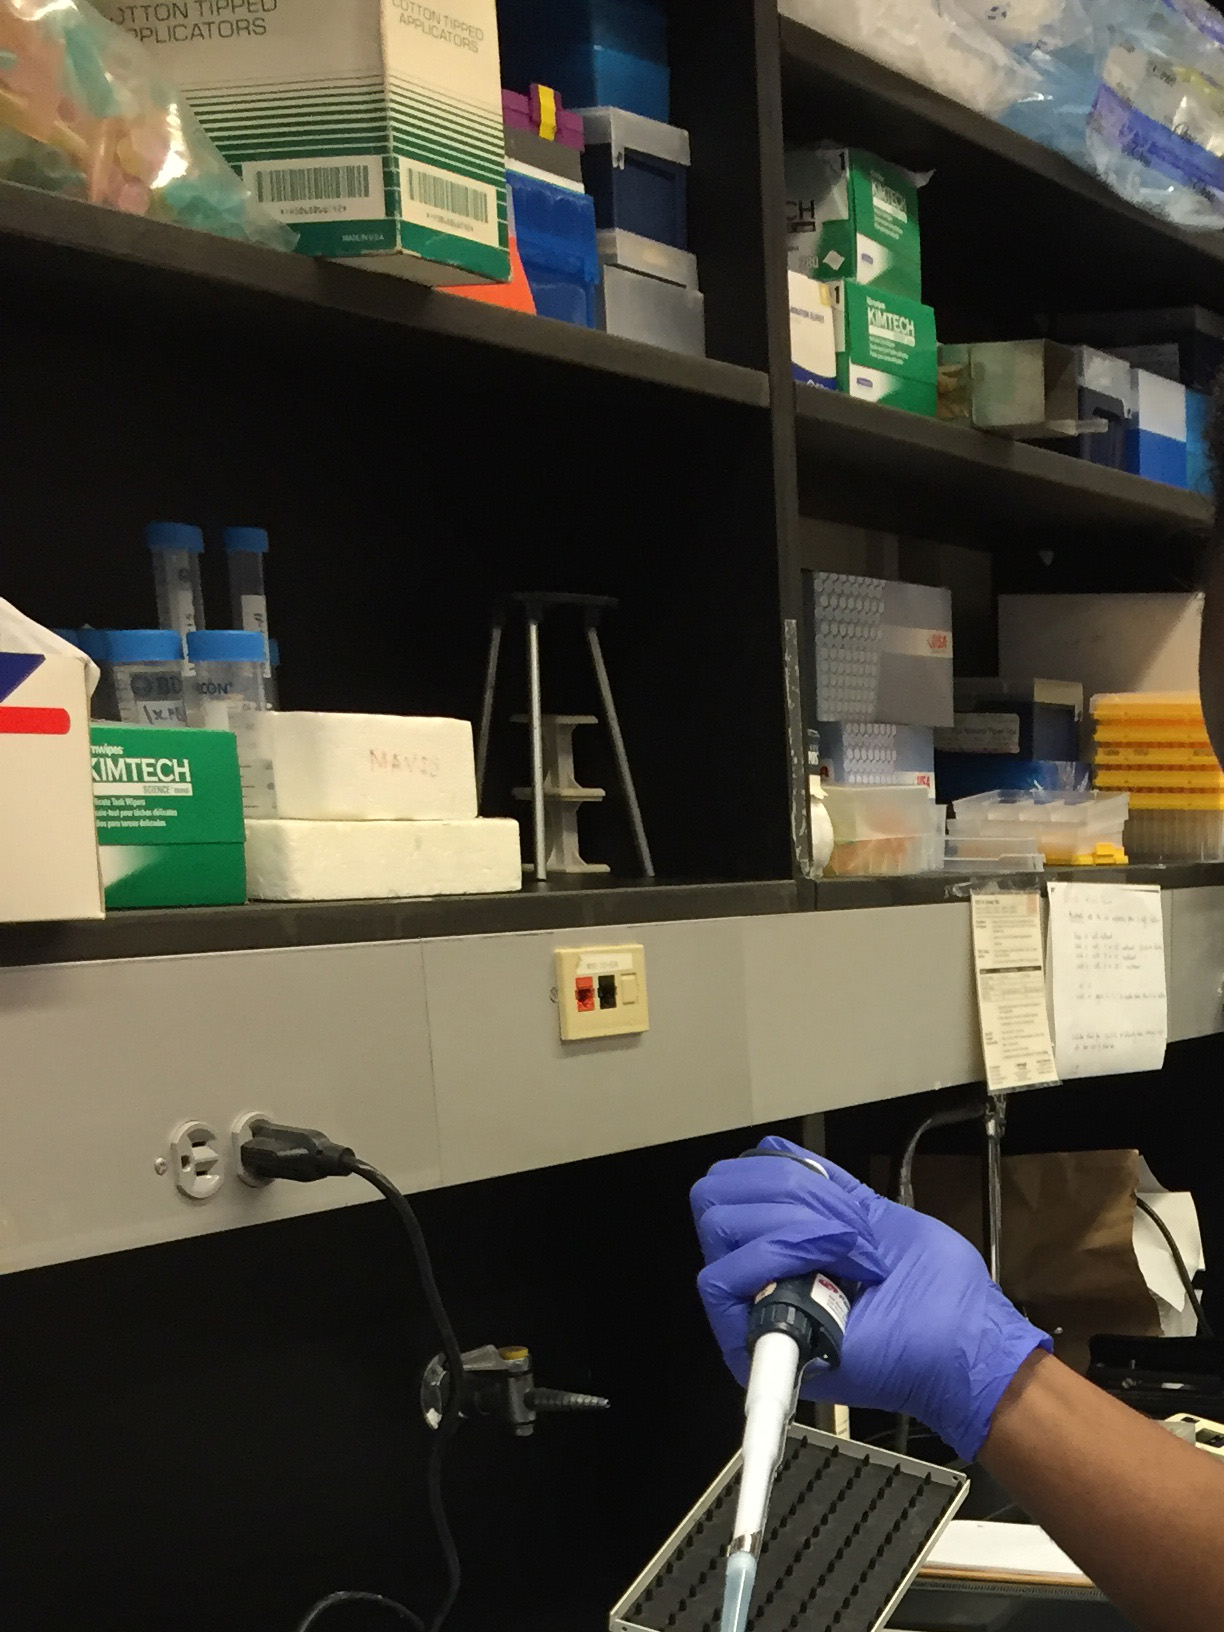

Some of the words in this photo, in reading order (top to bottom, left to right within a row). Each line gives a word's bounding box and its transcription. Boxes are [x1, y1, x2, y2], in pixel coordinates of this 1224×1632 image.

[110, 2, 188, 25] OTTON
[126, 17, 267, 43] PPLICATORS
[399, 13, 479, 53] APPLICATORS
[444, 15, 484, 41] TIPPED
[867, 307, 914, 336] KIMTECH
[91, 758, 191, 782] KIMTECH
